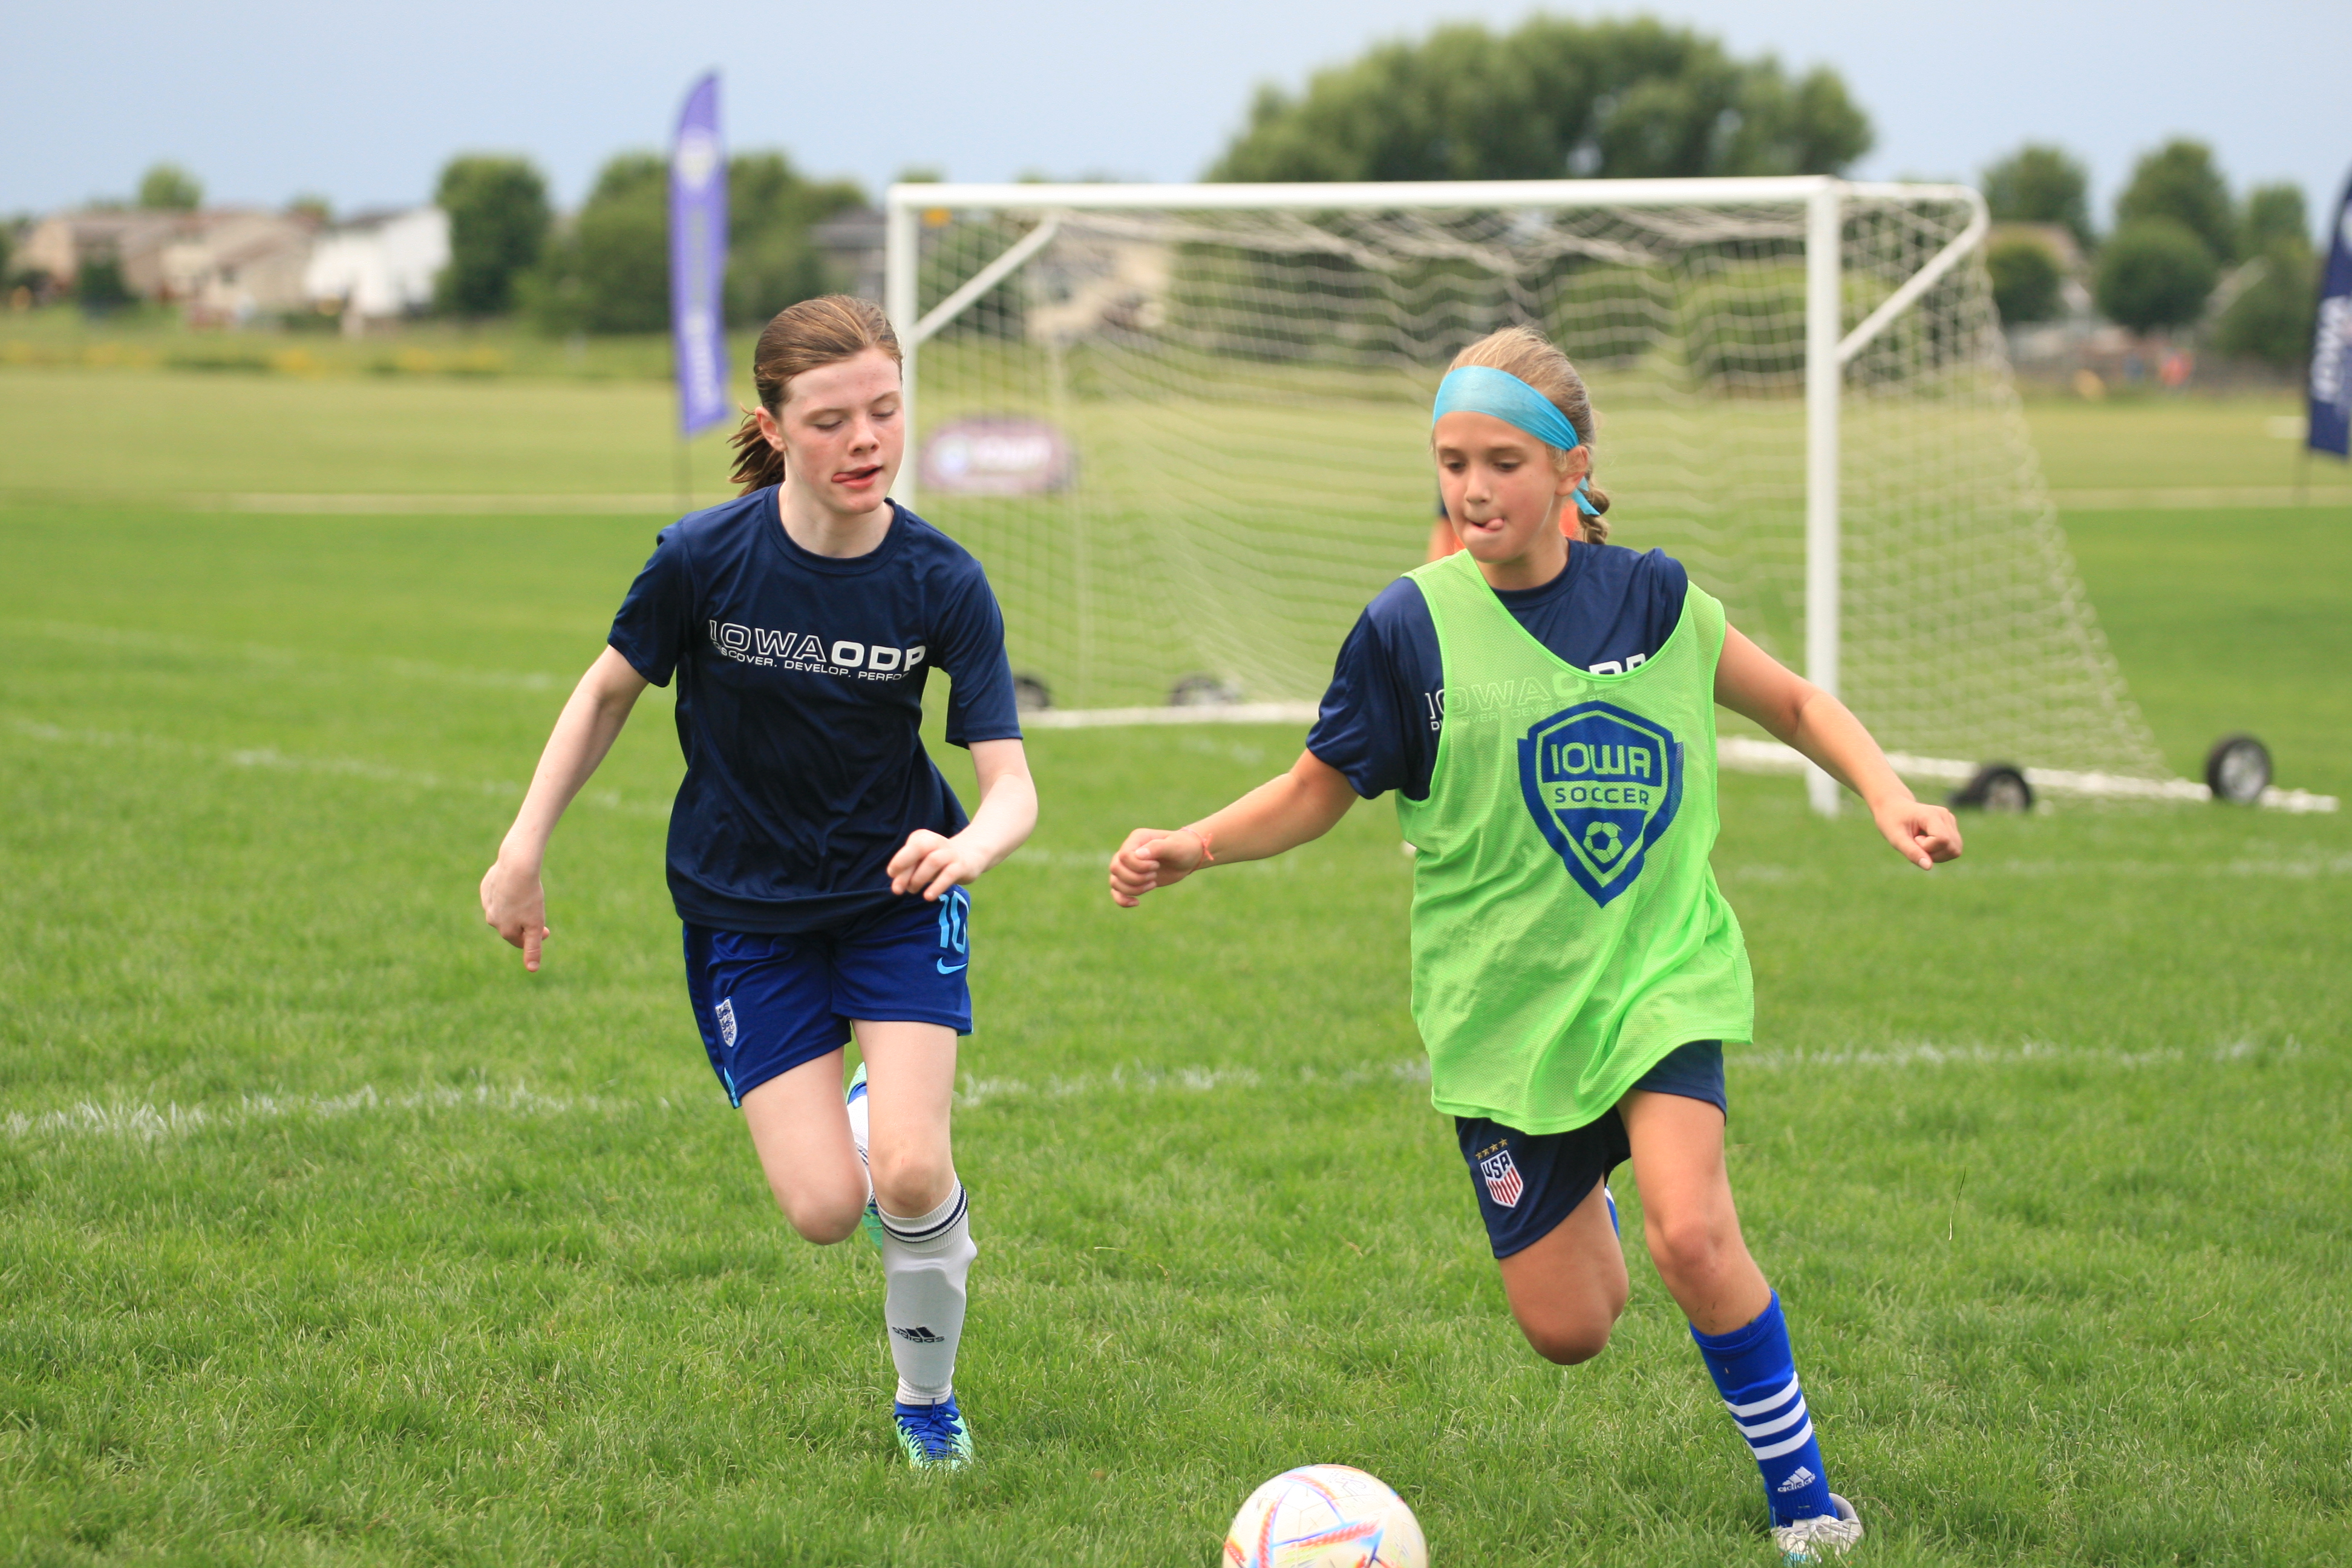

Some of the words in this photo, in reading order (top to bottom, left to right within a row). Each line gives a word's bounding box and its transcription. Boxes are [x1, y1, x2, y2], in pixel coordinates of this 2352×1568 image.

[784, 660, 851, 678] DEVELOP.
[858, 670, 909, 682] PERFO
[1550, 742, 1652, 779] IOWA
[1555, 786, 1650, 806] SOCCER
[1482, 1152, 1511, 1179] USA
[892, 1326, 945, 1343] adidas
[1777, 1473, 1816, 1493] adidas
